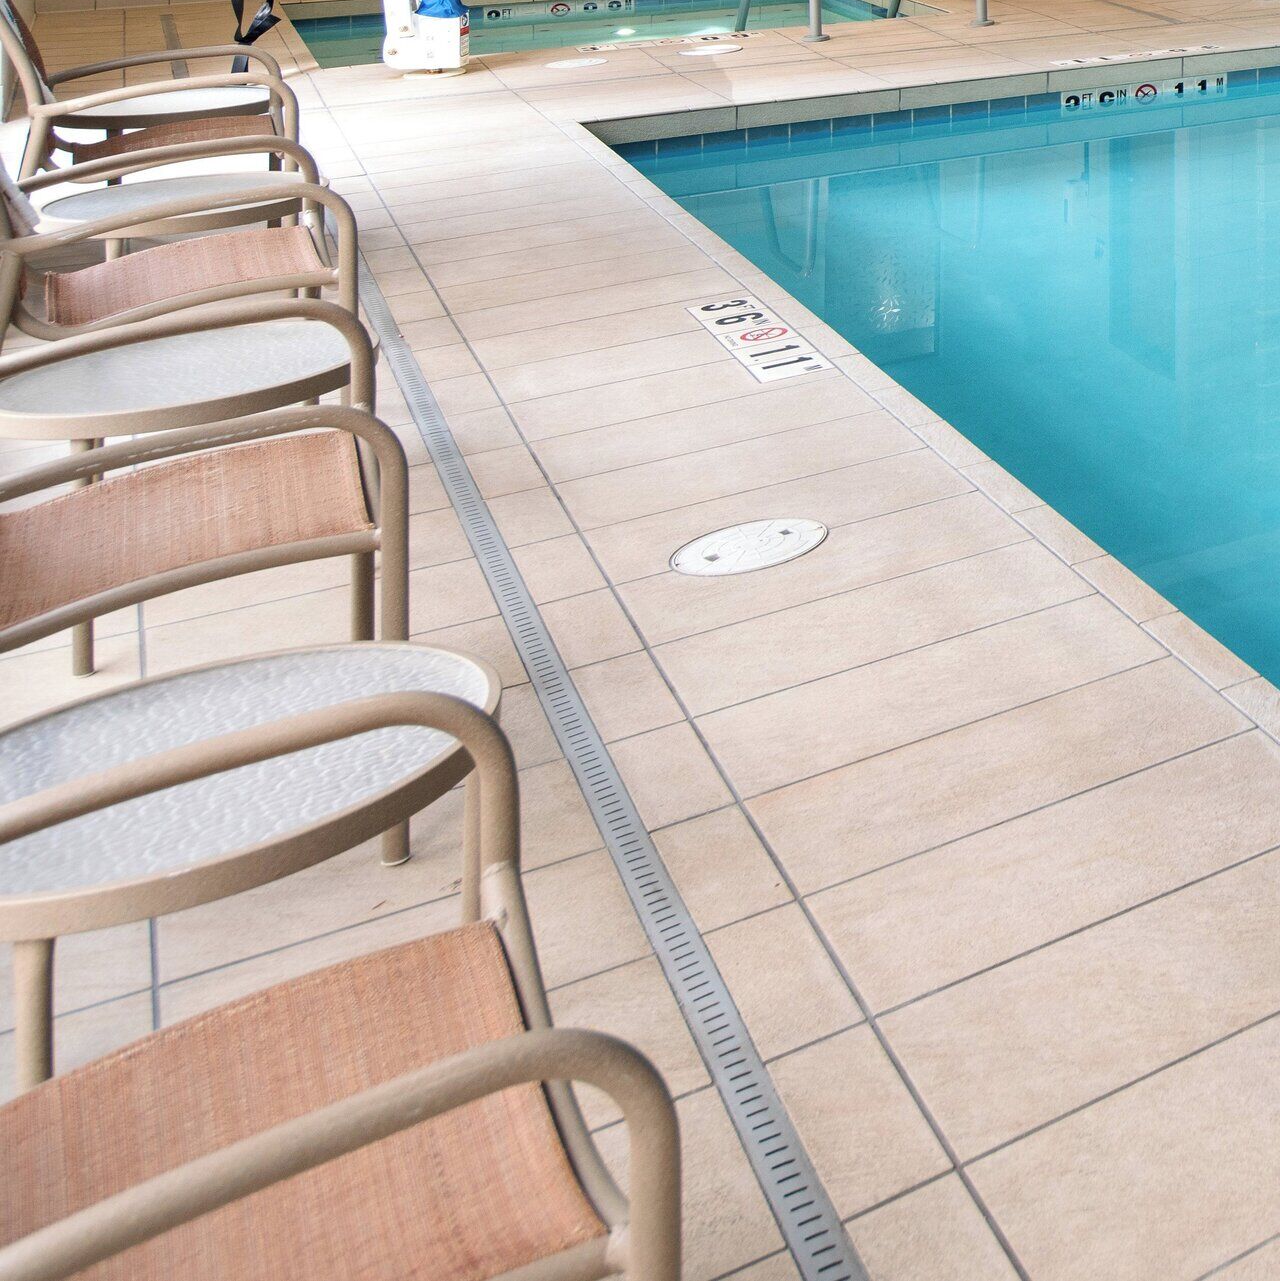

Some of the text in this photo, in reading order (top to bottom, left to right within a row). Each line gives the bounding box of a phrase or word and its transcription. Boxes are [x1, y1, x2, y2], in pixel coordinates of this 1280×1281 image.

[1082, 93, 1093, 102] FT
[1117, 89, 1127, 98] IN
[1216, 78, 1223, 86] M
[701, 299, 748, 311] 3
[715, 312, 763, 325] 6
